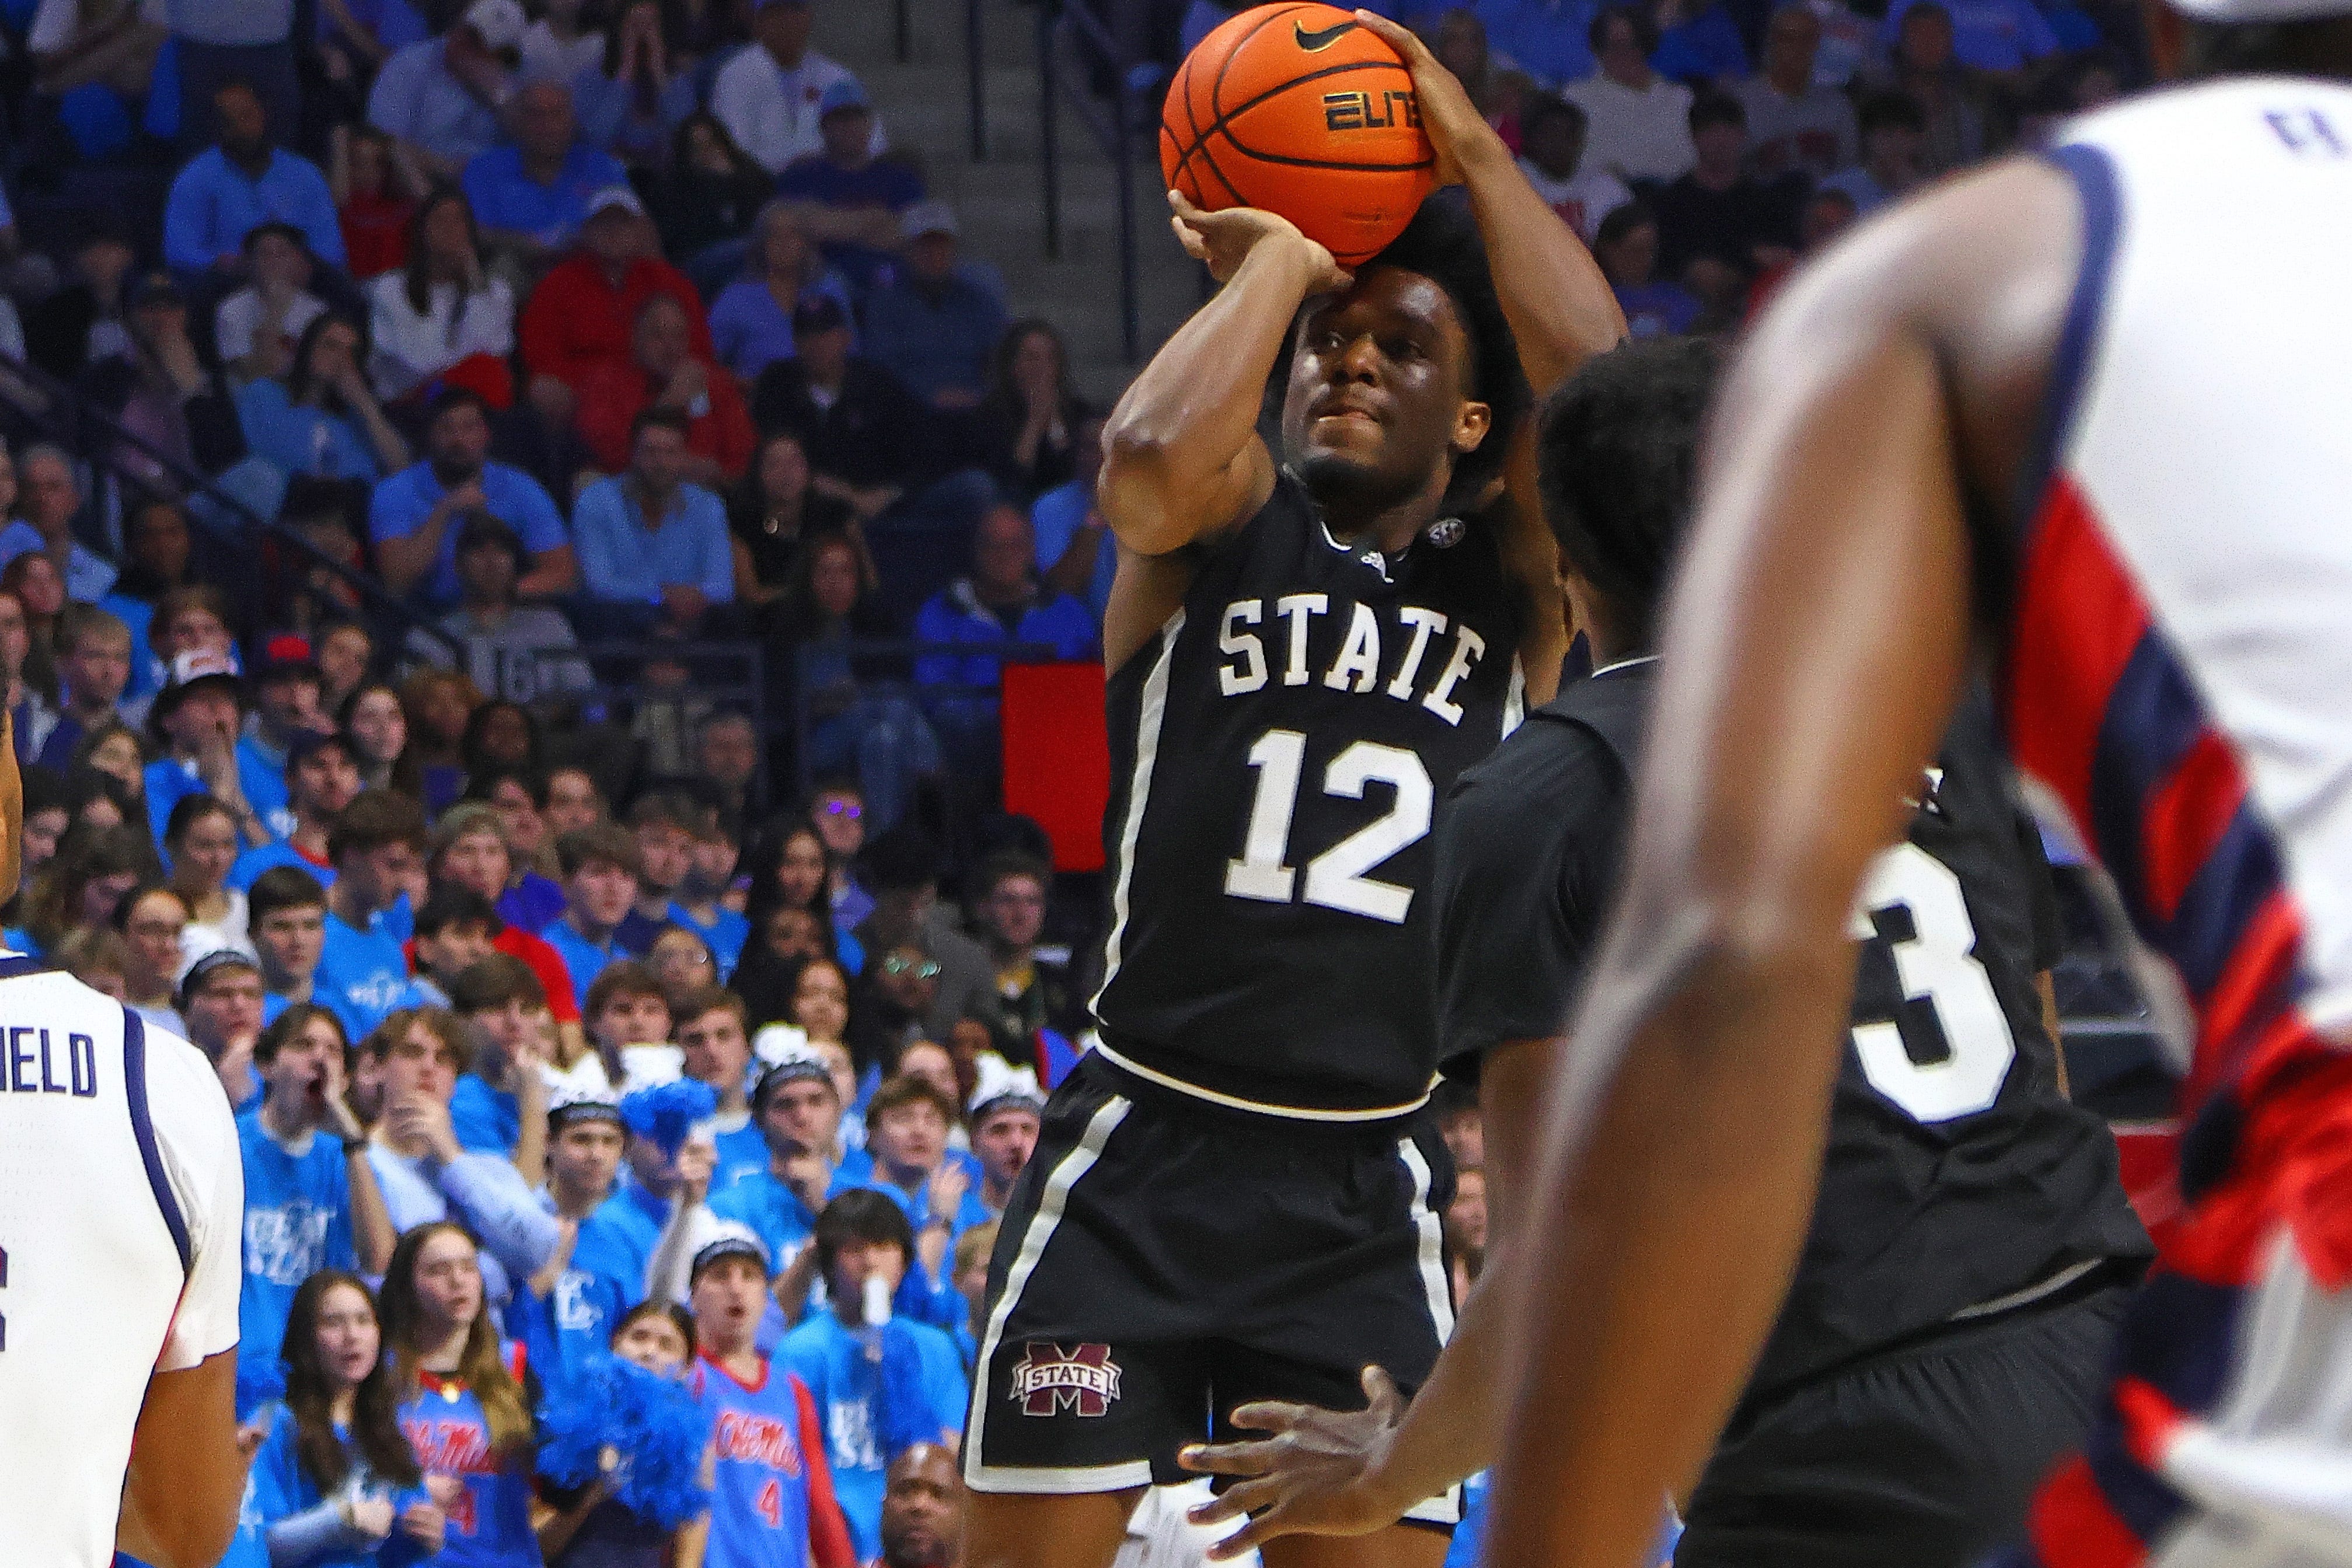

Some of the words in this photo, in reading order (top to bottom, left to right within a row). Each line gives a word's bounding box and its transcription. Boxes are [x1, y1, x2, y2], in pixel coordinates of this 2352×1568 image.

[1219, 592, 1485, 727] STATE
[1224, 729, 1434, 924] 12
[1845, 842, 2016, 1122] 3
[1032, 1366, 1102, 1389] STATE
[756, 1478, 781, 1528] 4
